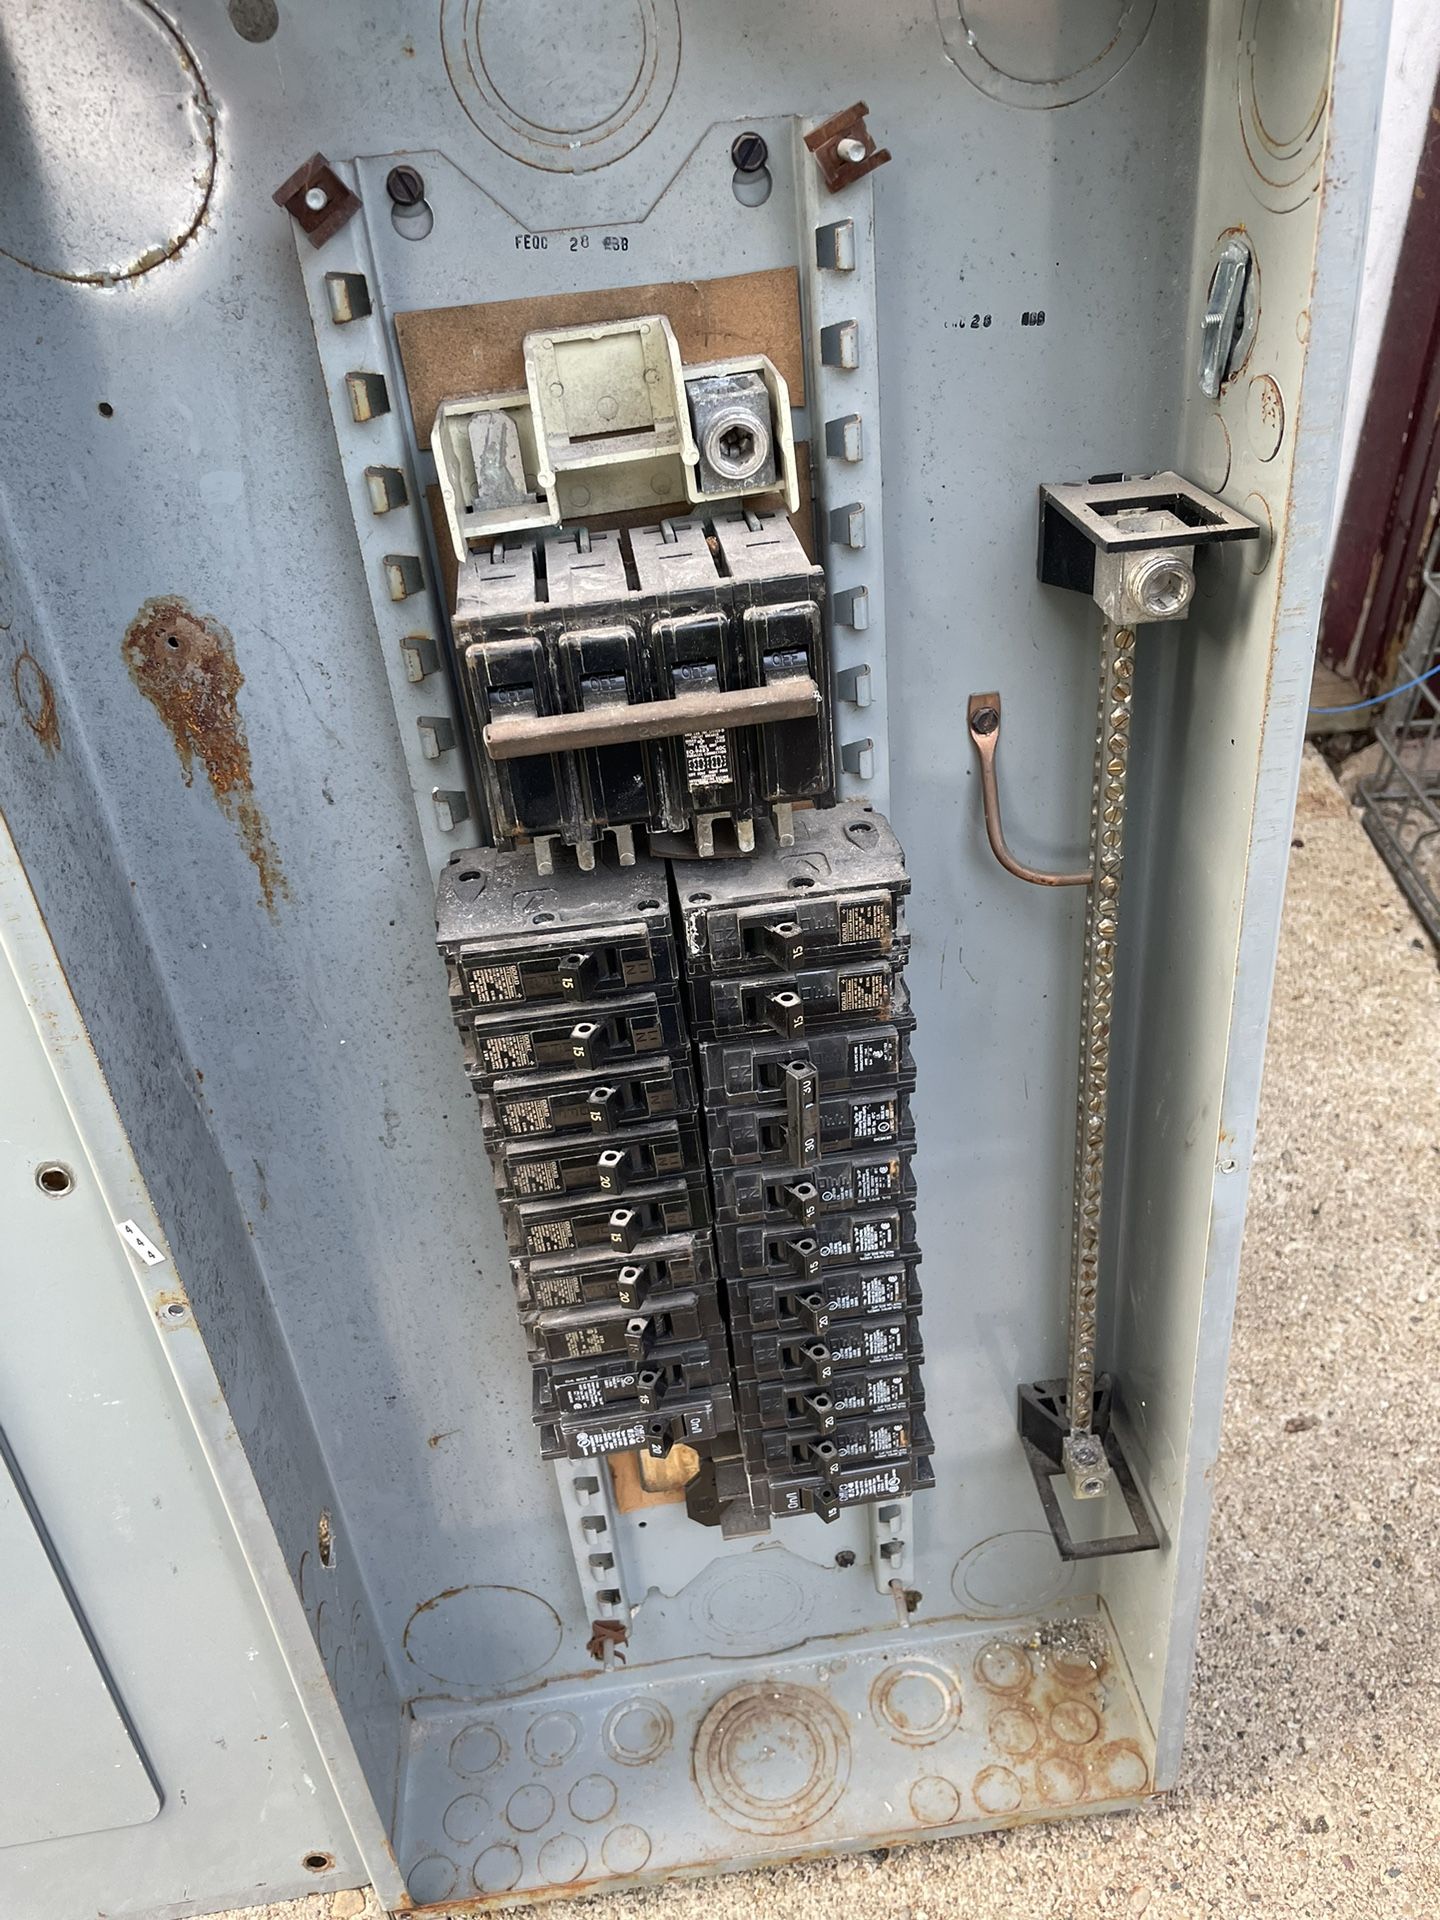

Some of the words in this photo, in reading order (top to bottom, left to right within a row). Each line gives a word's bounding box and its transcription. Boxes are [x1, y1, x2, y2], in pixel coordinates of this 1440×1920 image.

[569, 234, 590, 252] 28
[772, 652, 799, 668] OFF
[681, 664, 708, 680] OFF
[588, 675, 617, 692] OFF
[792, 945, 804, 960] 15
[561, 977, 573, 989] 15
[792, 1015, 804, 1029] 15
[572, 1046, 585, 1057] 15
[590, 1111, 602, 1122] 15
[804, 1138, 815, 1153] 30
[600, 1176, 611, 1188] 20
[806, 1206, 816, 1218] 15
[125, 1225, 133, 1234] 4
[136, 1238, 145, 1247] 4
[147, 1250, 156, 1259] 4
[610, 1232, 622, 1243] 15
[809, 1260, 819, 1273] 15
[619, 1292, 630, 1303] 20
[818, 1315, 829, 1328] 20
[821, 1366, 832, 1379] 20
[639, 1395, 649, 1405] 15
[824, 1416, 834, 1428] 20
[651, 1444, 662, 1454] 20
[829, 1463, 840, 1475] 20
[828, 1507, 838, 1518] 15
